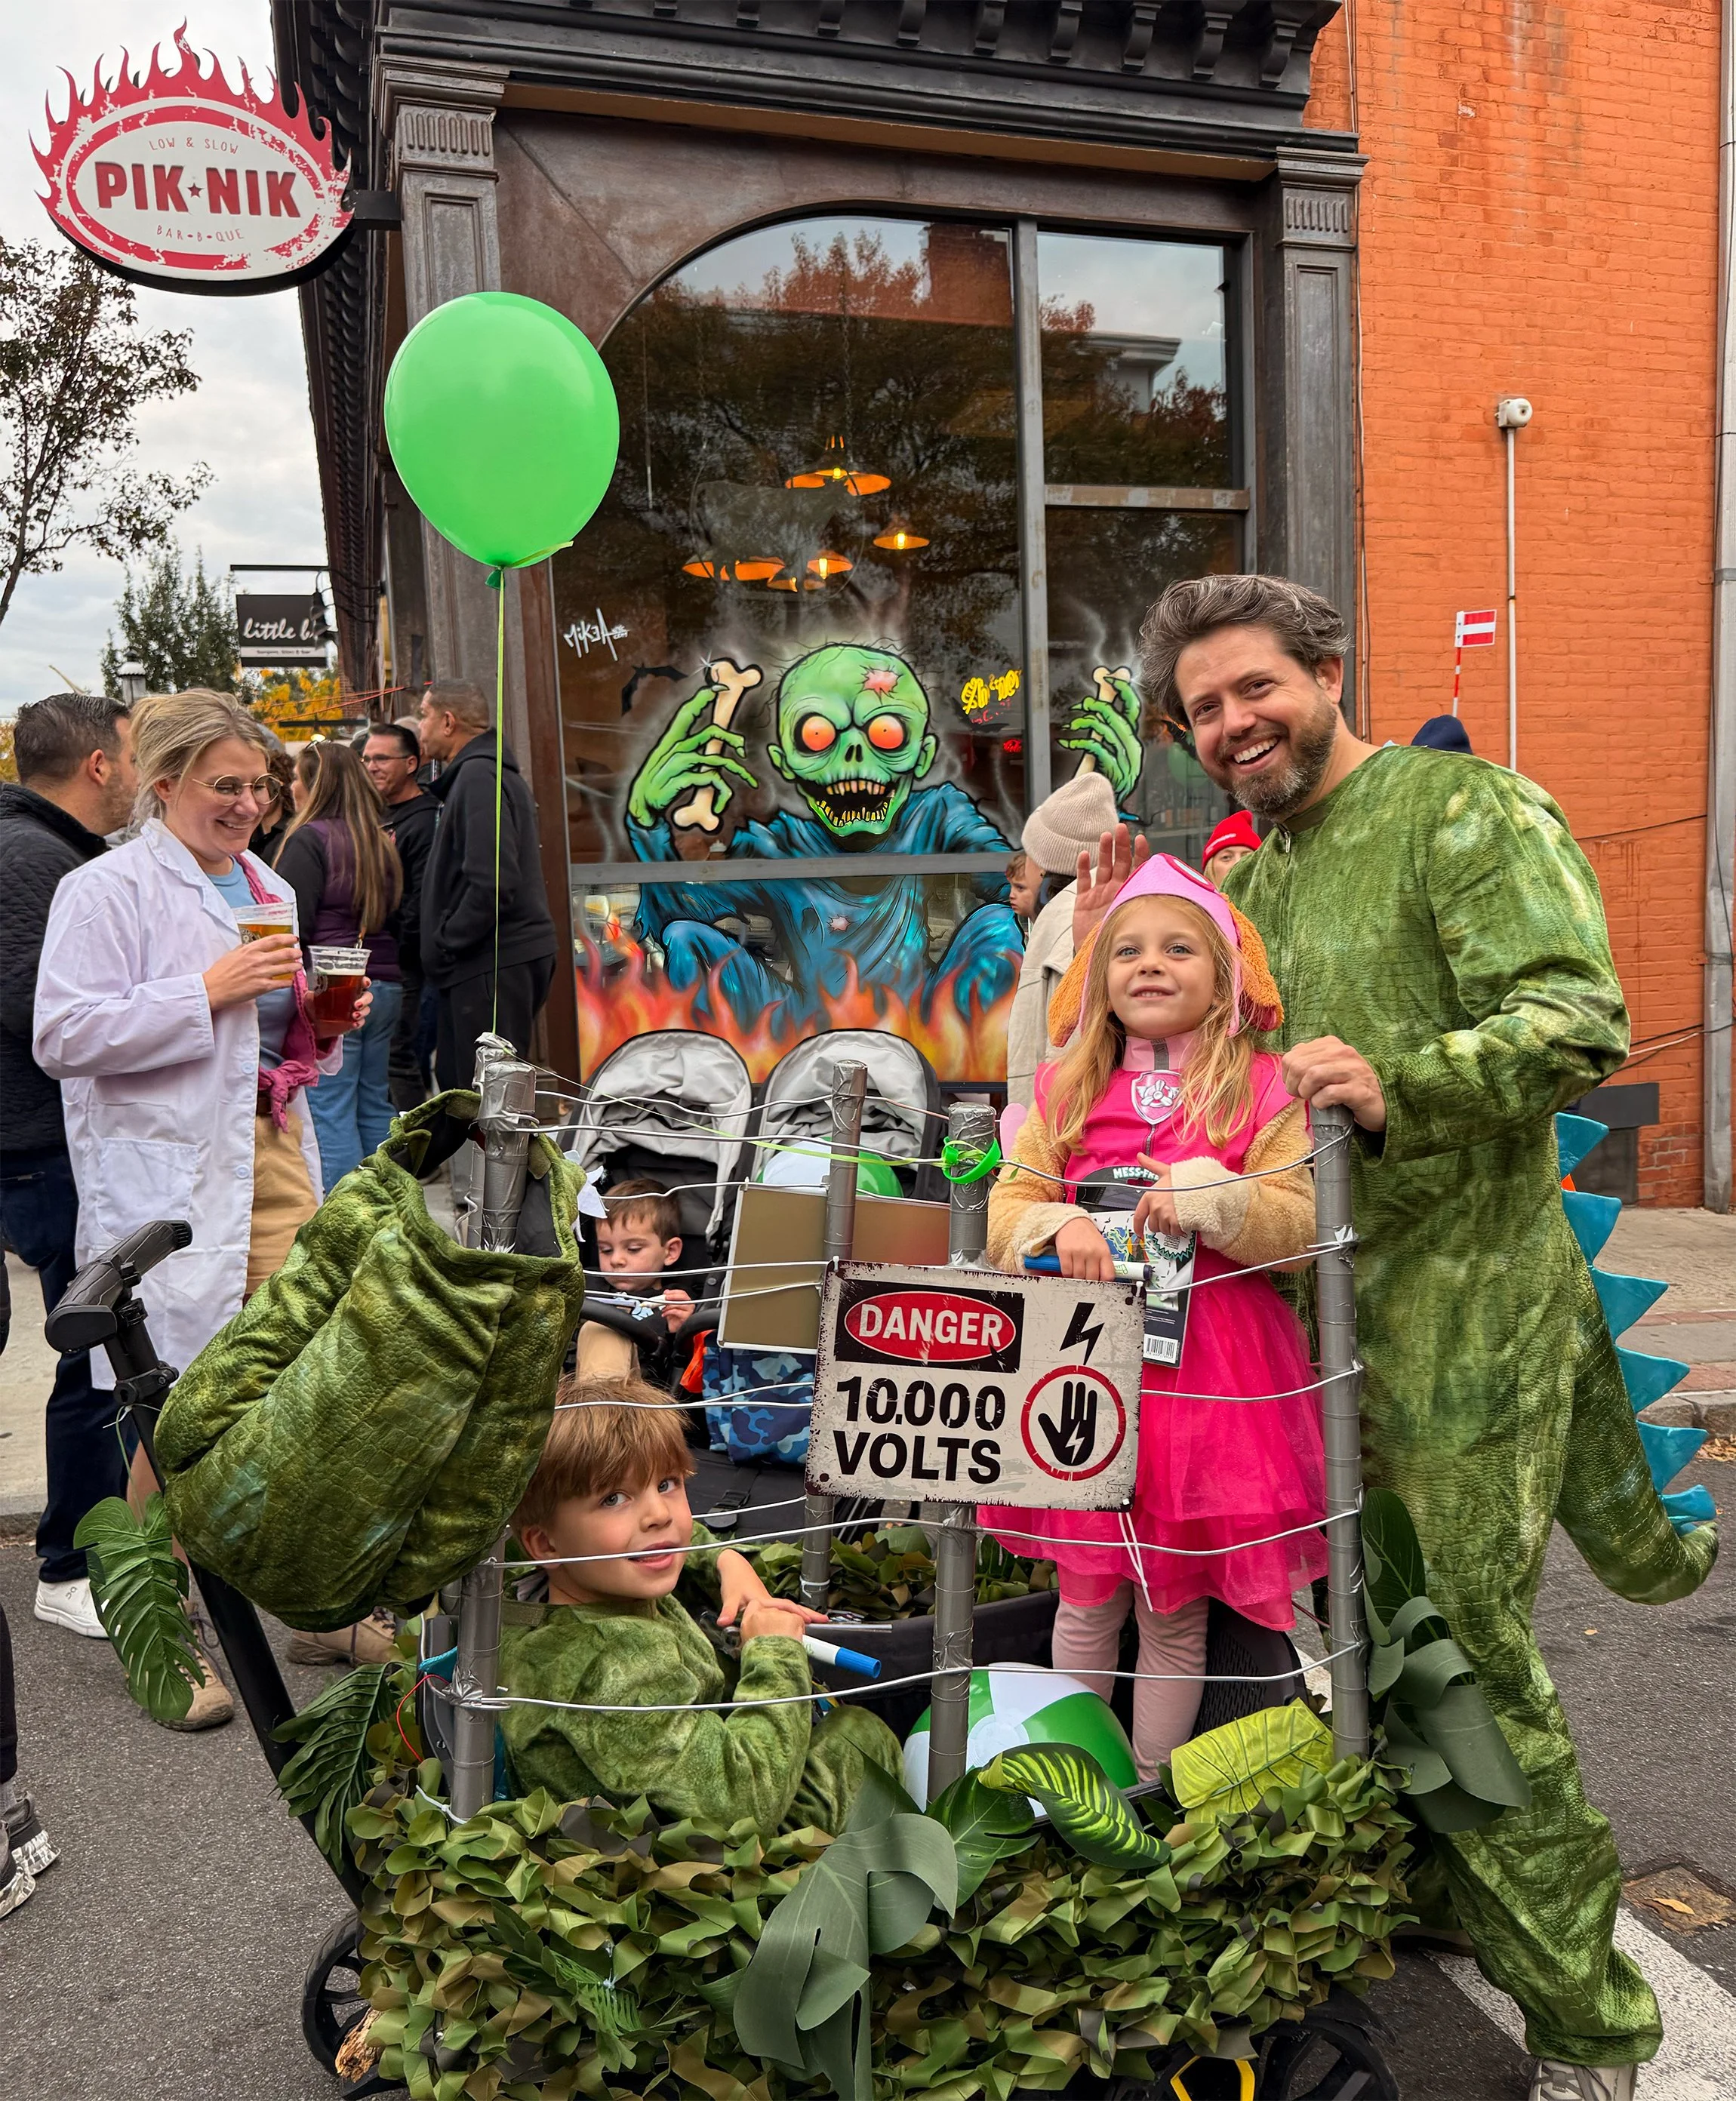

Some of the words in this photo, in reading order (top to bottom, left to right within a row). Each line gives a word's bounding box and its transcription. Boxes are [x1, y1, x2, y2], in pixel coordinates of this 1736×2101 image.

[149, 137, 175, 151] LOW
[186, 137, 194, 148] &
[205, 138, 239, 154] SLOW
[94, 161, 189, 213] PIK
[205, 167, 300, 218] NIK
[244, 617, 297, 640] little
[858, 1303, 1003, 1348] DANGER
[836, 1376, 1006, 1432] 10.000
[833, 1430, 1002, 1484] VOLTS
